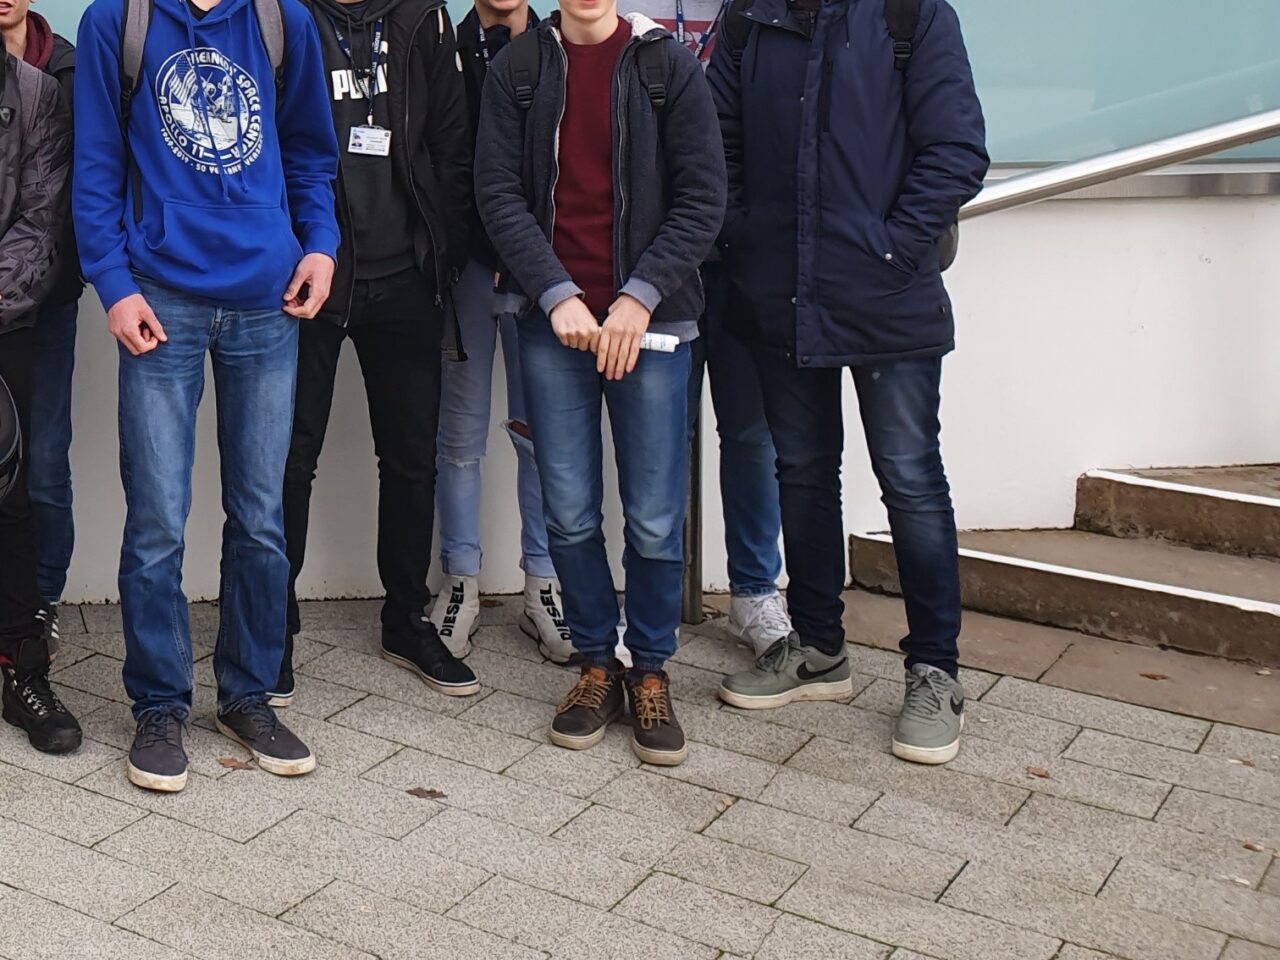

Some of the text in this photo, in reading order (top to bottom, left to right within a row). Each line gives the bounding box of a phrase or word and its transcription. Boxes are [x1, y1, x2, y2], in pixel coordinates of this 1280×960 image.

[235, 74, 262, 111] SPACE
[331, 63, 388, 101] PUM
[159, 96, 204, 159] APOLLO 11
[440, 581, 465, 638] DIESEL
[540, 583, 572, 641] DIESEL
